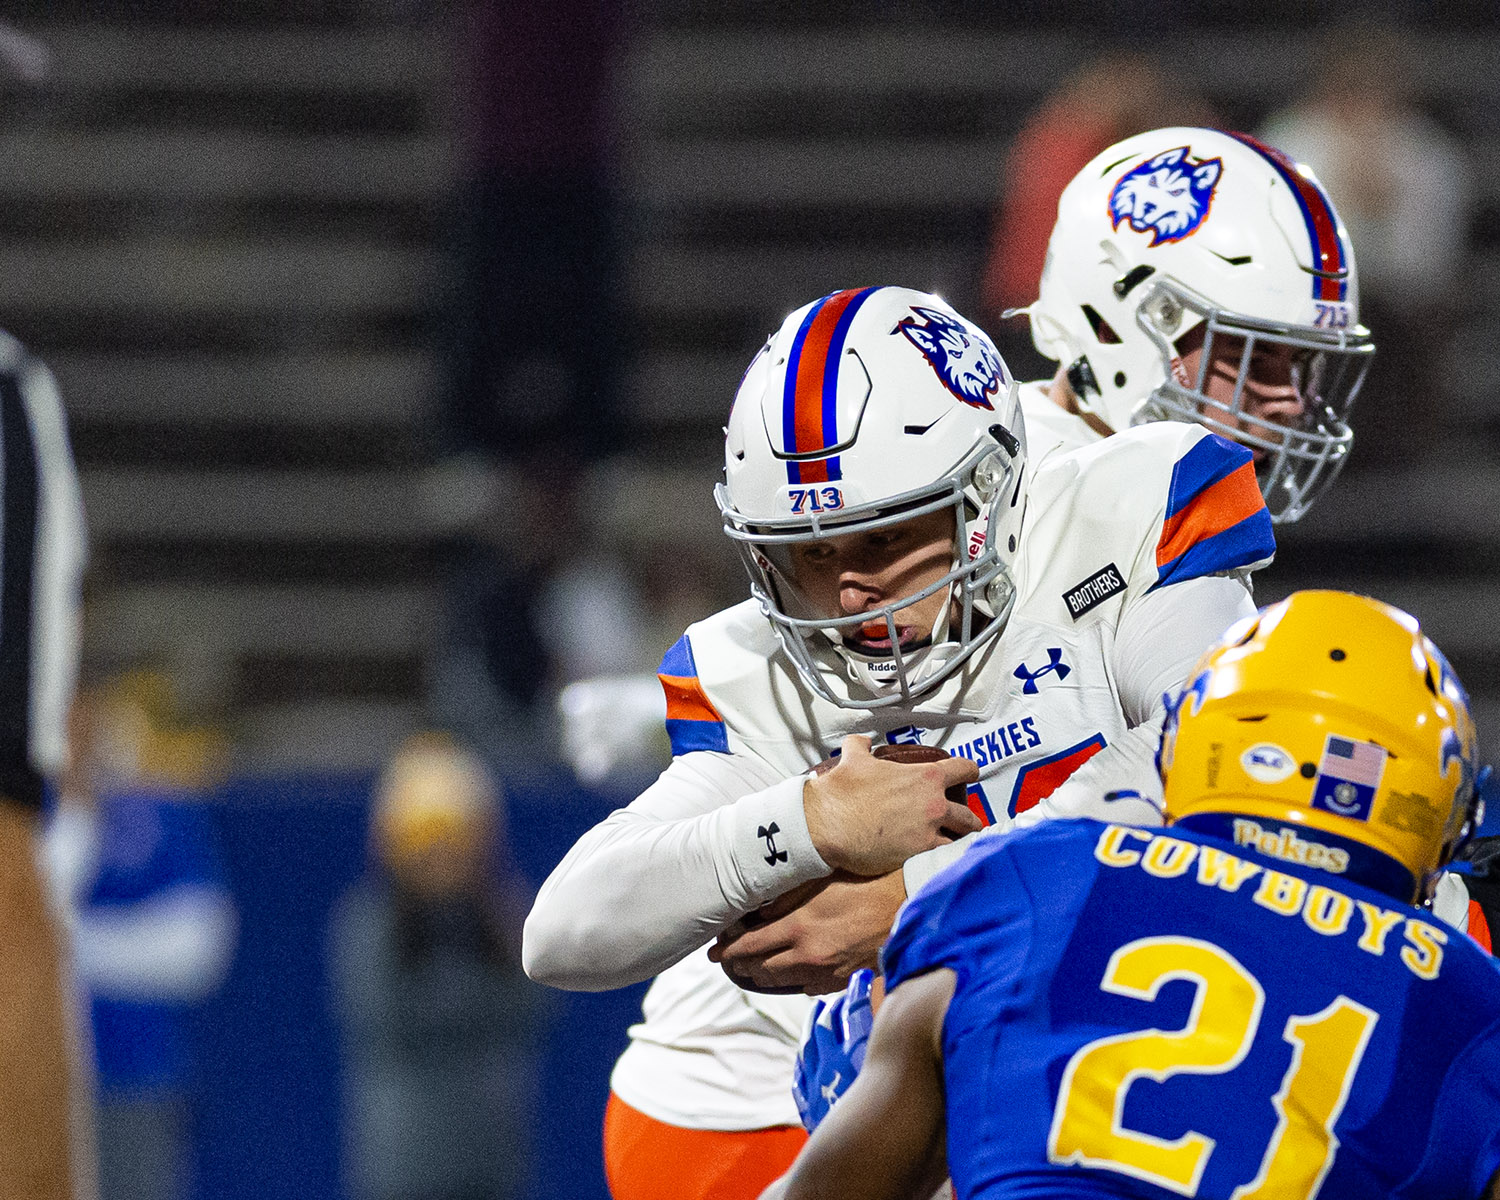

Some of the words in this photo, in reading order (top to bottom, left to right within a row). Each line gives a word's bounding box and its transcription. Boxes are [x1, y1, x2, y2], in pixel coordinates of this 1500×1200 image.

[788, 486, 845, 515] 713
[1068, 569, 1121, 613] BROTHERS
[867, 662, 897, 671] Ridde
[950, 716, 1042, 769] USKIES
[1094, 824, 1449, 980] COWBOYS
